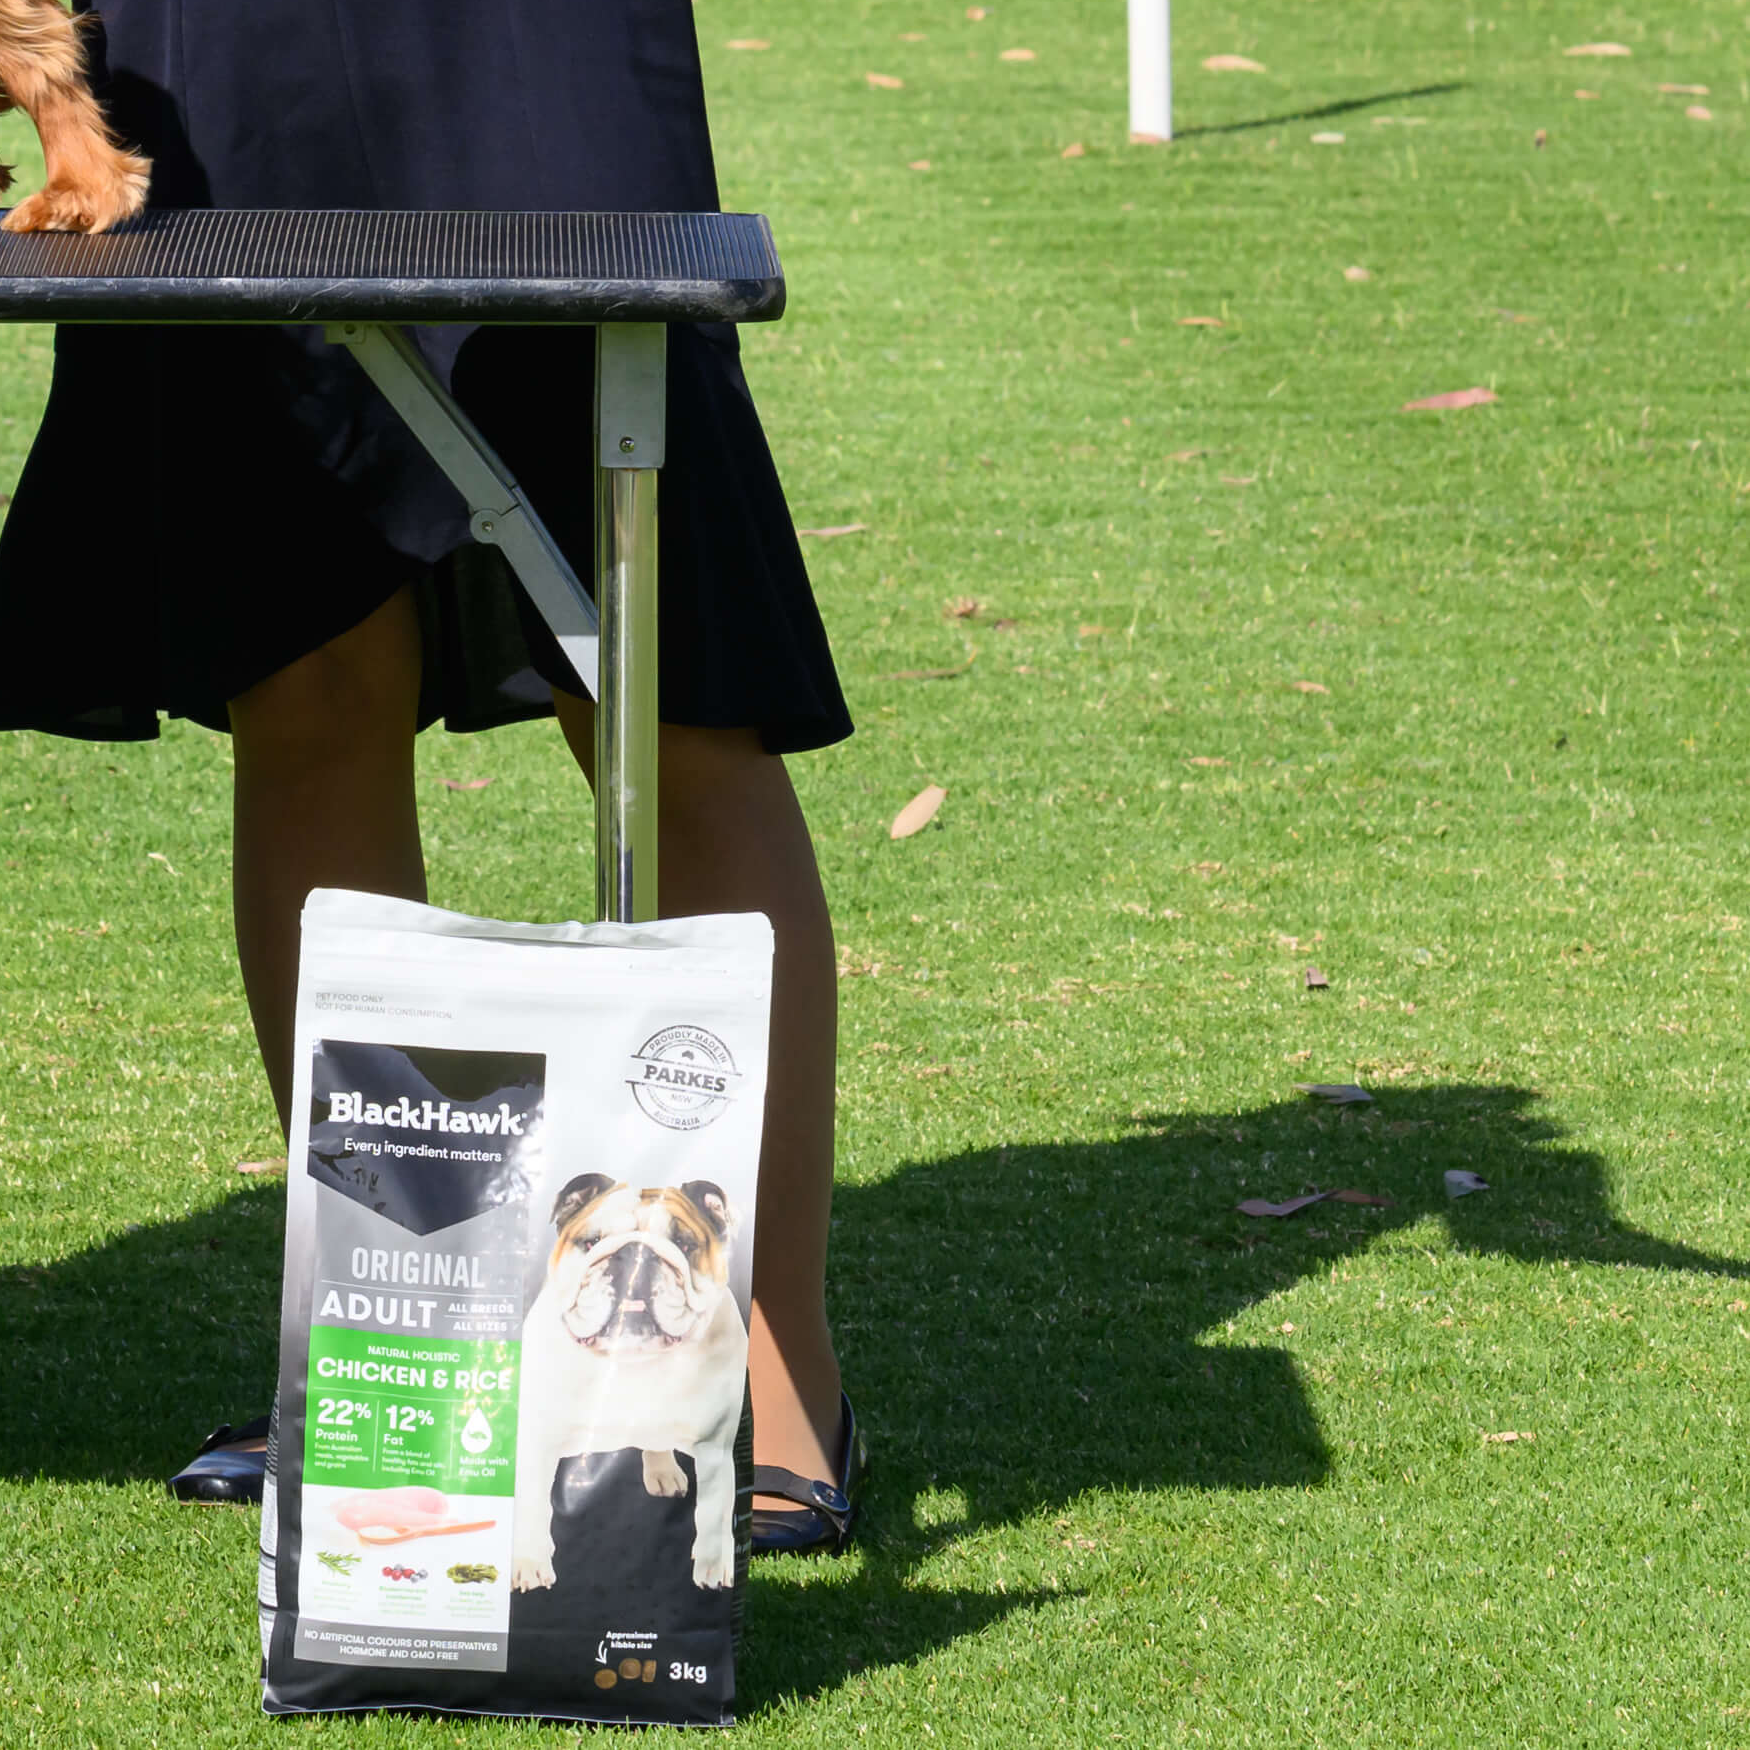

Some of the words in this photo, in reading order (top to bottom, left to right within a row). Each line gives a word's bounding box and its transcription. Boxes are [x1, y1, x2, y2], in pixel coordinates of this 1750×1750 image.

[332, 993, 359, 1002] FOOD
[361, 994, 384, 1003] ONLY
[315, 1002, 332, 1011] NOT
[355, 1005, 385, 1014] HUMAN
[649, 1031, 691, 1050] PROUDLY
[695, 1033, 721, 1053] MADE
[643, 1064, 726, 1092] PARKES
[654, 1111, 700, 1126] AUSTRALIA
[345, 1138, 381, 1156] Every
[384, 1140, 448, 1159] ingredient
[450, 1148, 502, 1162] matters
[352, 1247, 485, 1289] ORIGINAL
[319, 1289, 437, 1329] ADULT
[448, 1303, 469, 1313] ALL
[453, 1321, 472, 1331] ALL
[368, 1345, 410, 1360] NATURAL
[412, 1350, 460, 1363] HOLISTIC
[317, 1357, 426, 1388] CHICKEN
[432, 1369, 449, 1389] &
[455, 1369, 512, 1392] RICE
[317, 1398, 372, 1425] 22%
[385, 1404, 434, 1432] 12%
[315, 1428, 358, 1442] Protein
[383, 1433, 404, 1446] Fat
[459, 1456, 486, 1465] Made
[488, 1456, 509, 1466] with
[481, 1467, 496, 1476] Oil
[304, 1629, 318, 1639] NO
[319, 1632, 366, 1644] ARTIFICIAL
[367, 1636, 412, 1648] COLOURS
[414, 1638, 428, 1649] OR
[429, 1640, 498, 1652] PRESERVATIVES
[605, 1630, 658, 1641] Approximate
[339, 1645, 386, 1658] HORMONE
[389, 1648, 408, 1659] AND
[410, 1649, 435, 1660] GMO
[436, 1650, 459, 1660] FREE
[637, 1641, 652, 1649] size
[669, 1661, 707, 1684] 3kg
